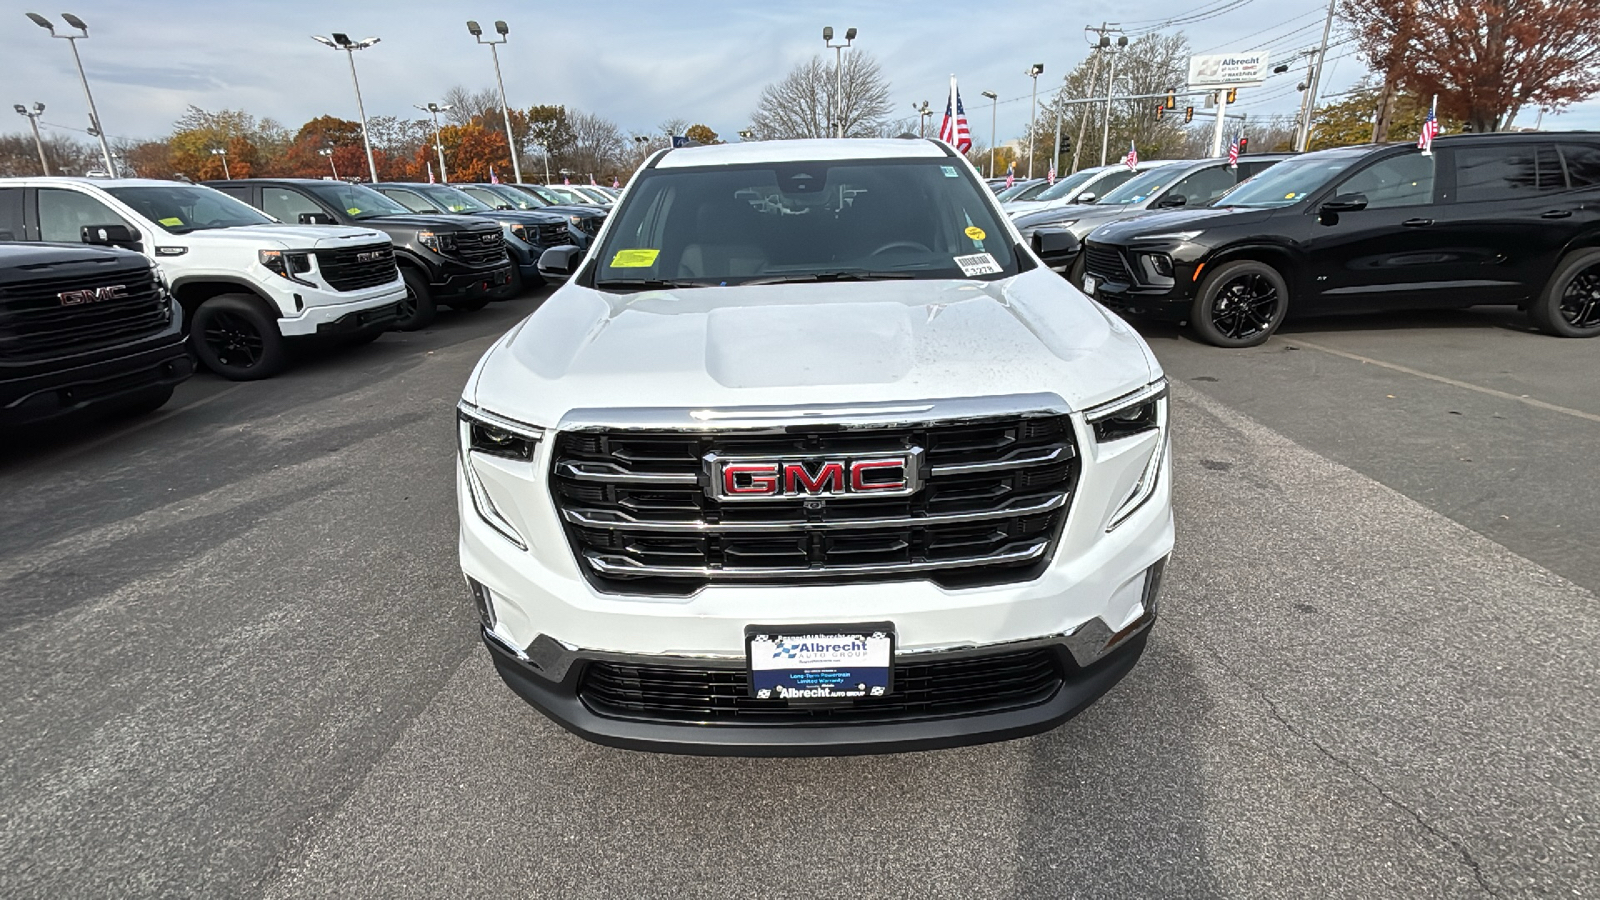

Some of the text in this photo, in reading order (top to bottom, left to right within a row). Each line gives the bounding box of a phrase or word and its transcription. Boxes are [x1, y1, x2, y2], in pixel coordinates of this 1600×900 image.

[1222, 57, 1259, 66] Albrecht
[57, 284, 129, 306] GMC
[721, 457, 907, 496] GMC
[799, 641, 868, 653] Albrecht
[779, 688, 830, 698] Albrecht
